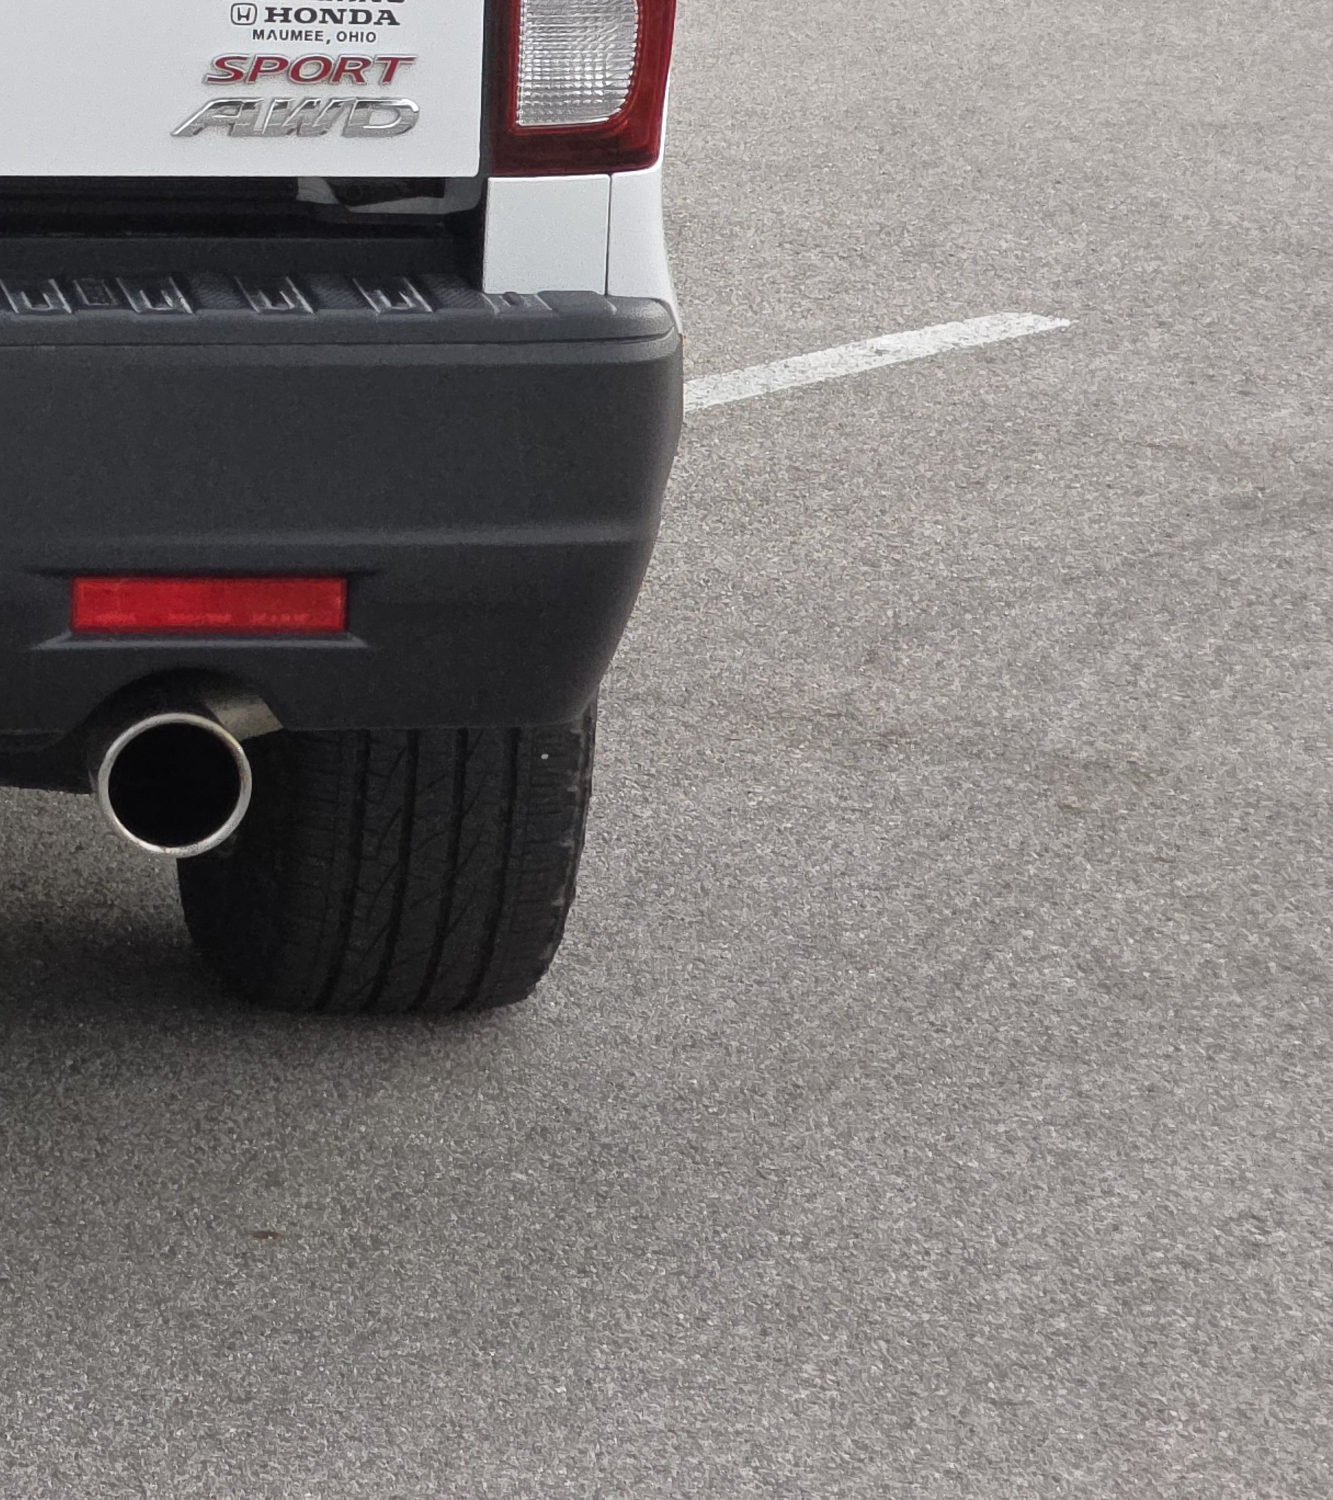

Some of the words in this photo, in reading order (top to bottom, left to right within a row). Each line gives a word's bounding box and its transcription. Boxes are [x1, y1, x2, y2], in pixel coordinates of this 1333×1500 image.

[263, 7, 401, 26] HONDA
[251, 28, 331, 45] MAUMEE,
[335, 30, 377, 44] OHIO
[202, 53, 419, 86] SPORT
[170, 96, 421, 138] AWD
